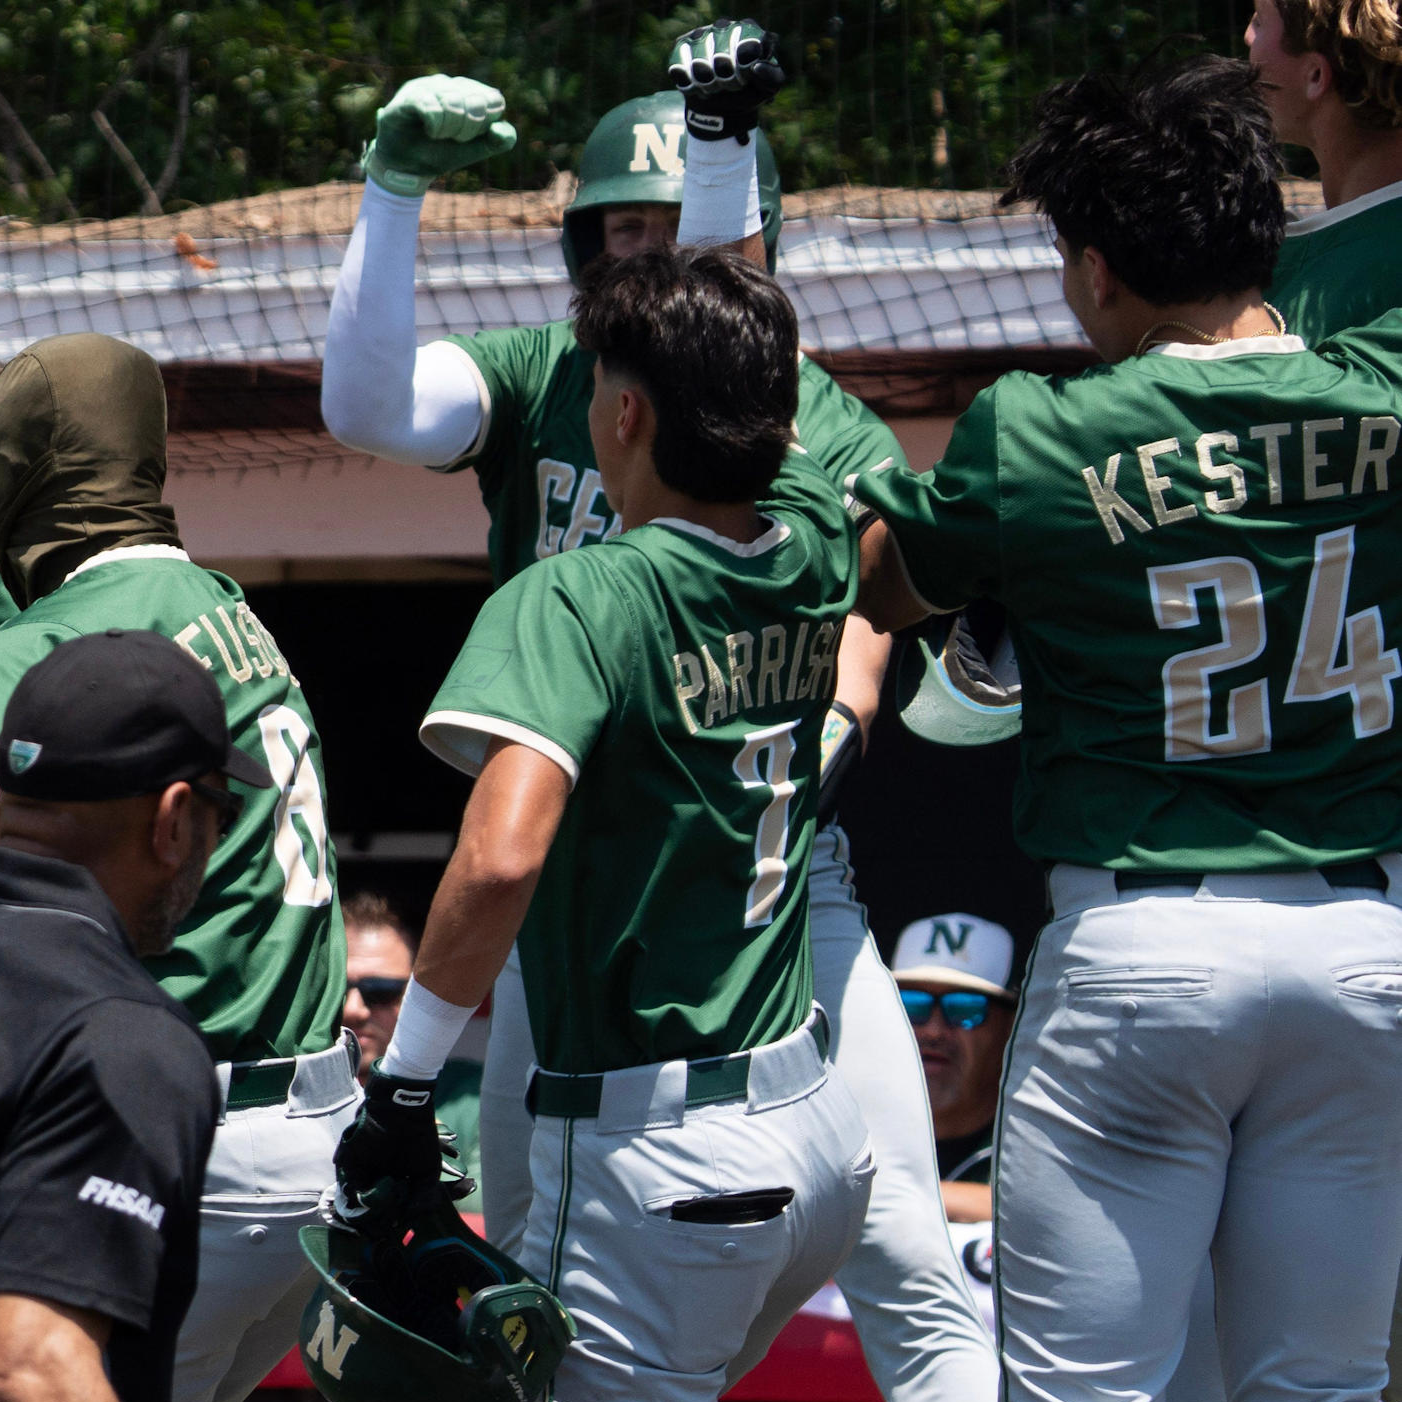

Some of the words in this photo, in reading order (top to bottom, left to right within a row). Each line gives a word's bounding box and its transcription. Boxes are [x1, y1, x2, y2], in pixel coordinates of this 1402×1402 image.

[630, 123, 686, 173] N
[1082, 416, 1402, 546] KESTER
[673, 615, 846, 736] PARRISH
[1147, 524, 1402, 763] 24
[925, 920, 976, 956] N
[306, 1306, 361, 1382] N
